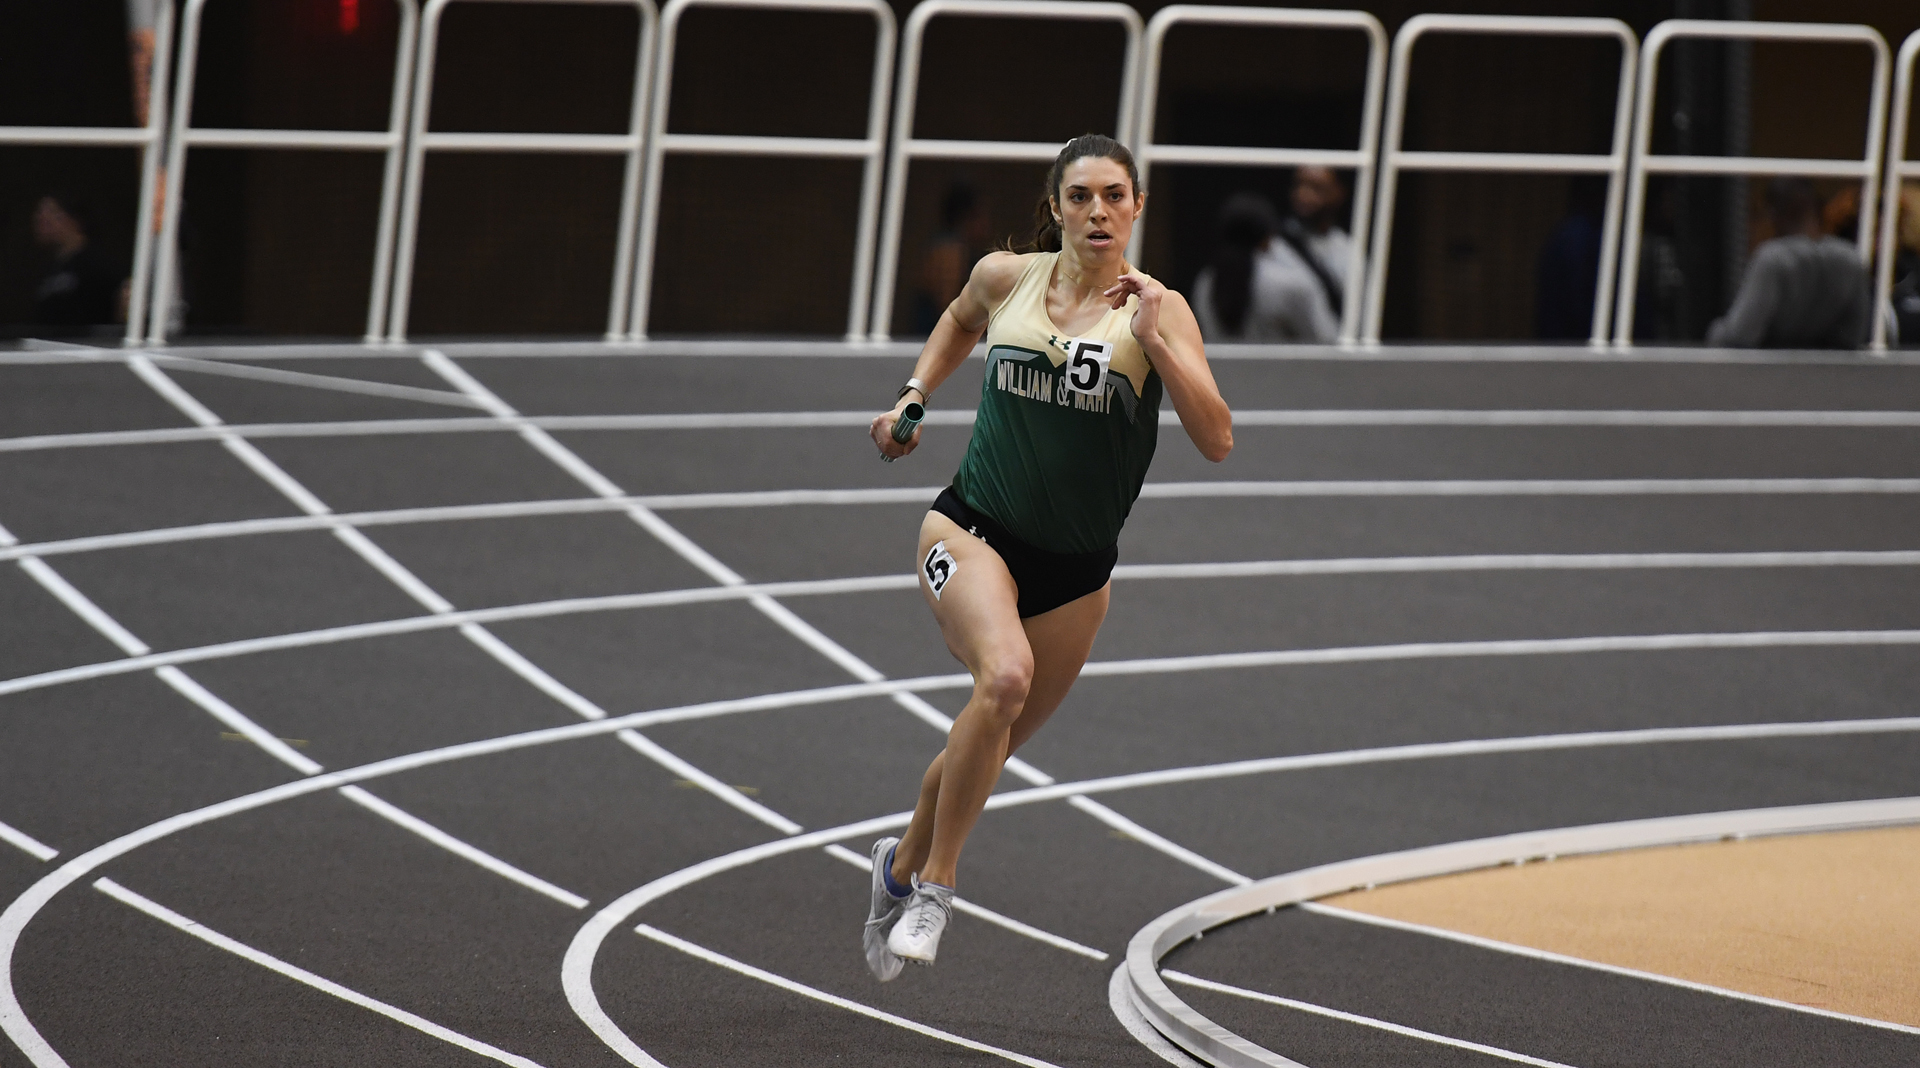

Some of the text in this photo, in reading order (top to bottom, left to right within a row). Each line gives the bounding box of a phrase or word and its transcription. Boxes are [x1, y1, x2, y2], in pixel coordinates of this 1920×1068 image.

[997, 359, 1053, 404] WILLIAM
[1056, 375, 1070, 407] &
[1070, 342, 1104, 391] 5
[925, 547, 950, 592] 5
